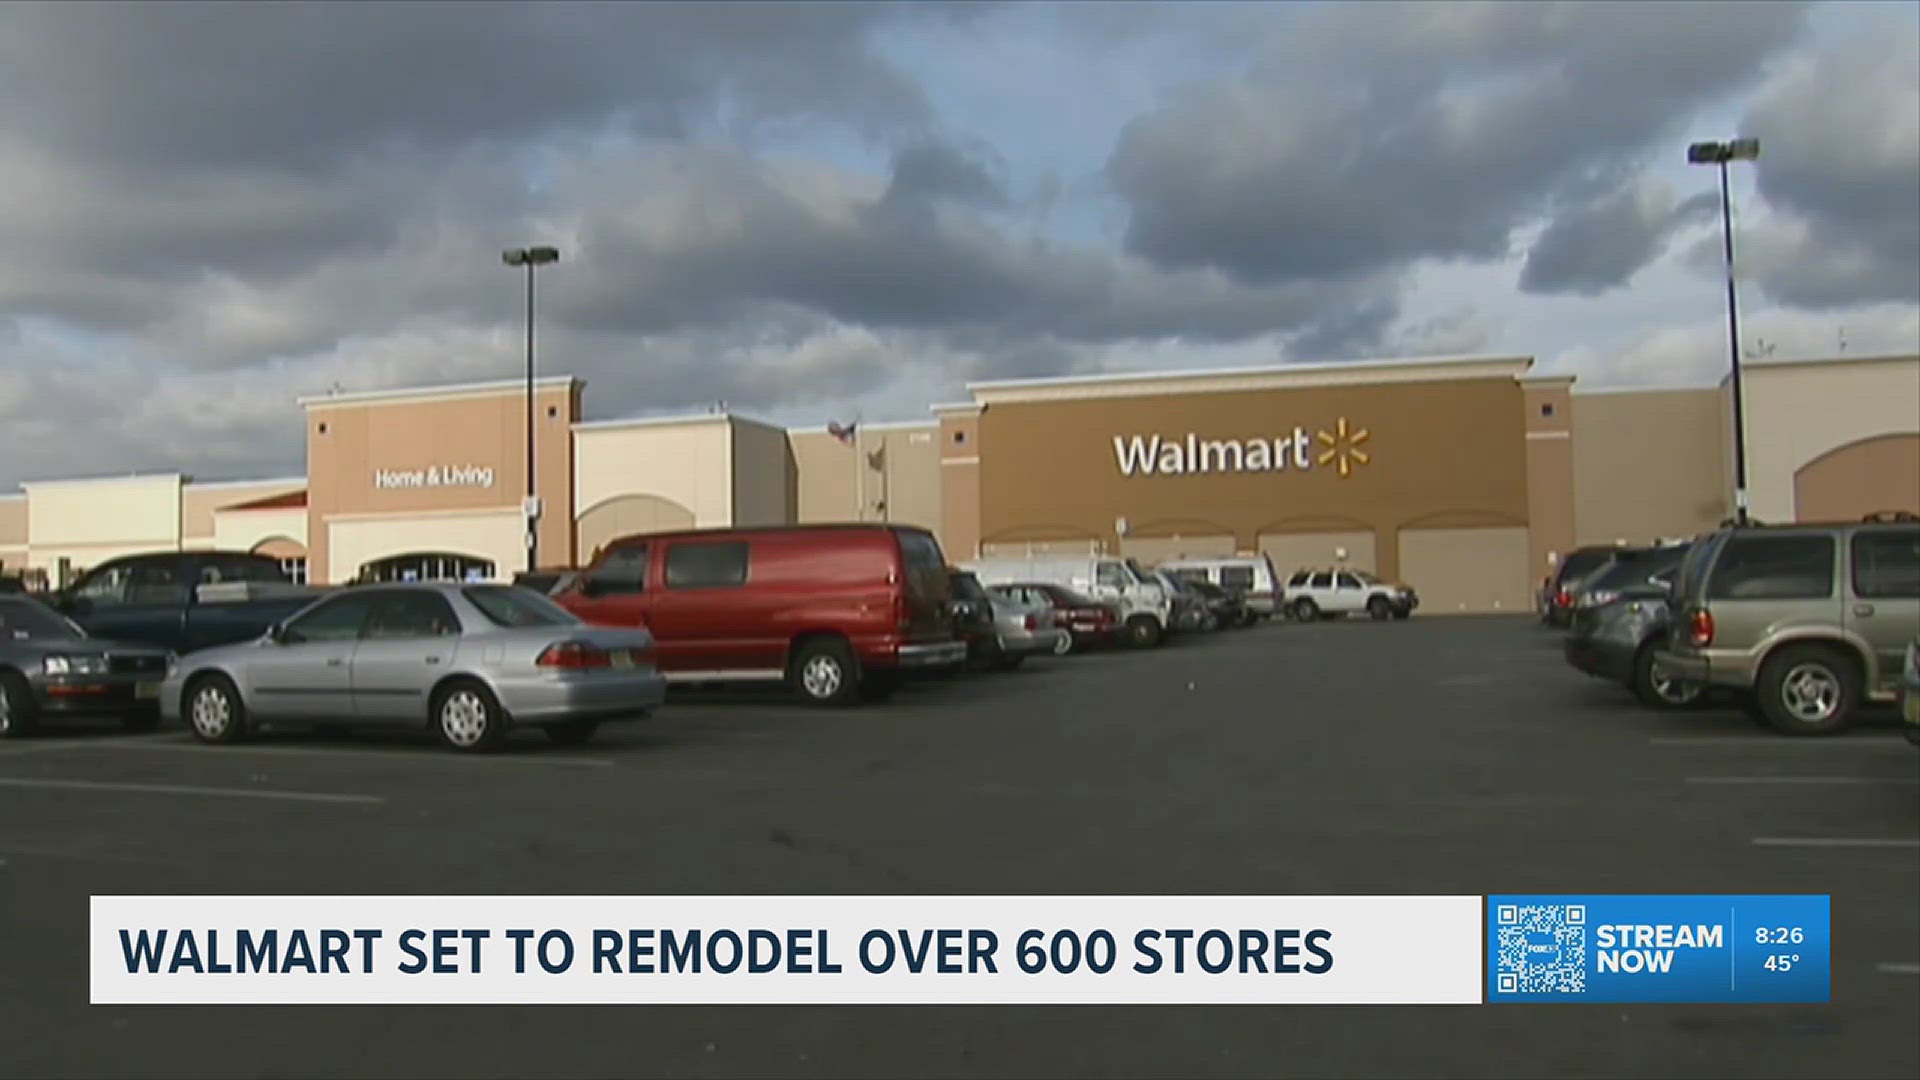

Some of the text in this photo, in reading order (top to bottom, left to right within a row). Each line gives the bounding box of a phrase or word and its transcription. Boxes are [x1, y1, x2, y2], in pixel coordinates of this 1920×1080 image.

[1112, 426, 1310, 476] Walmart
[375, 462, 494, 489] Home & Living
